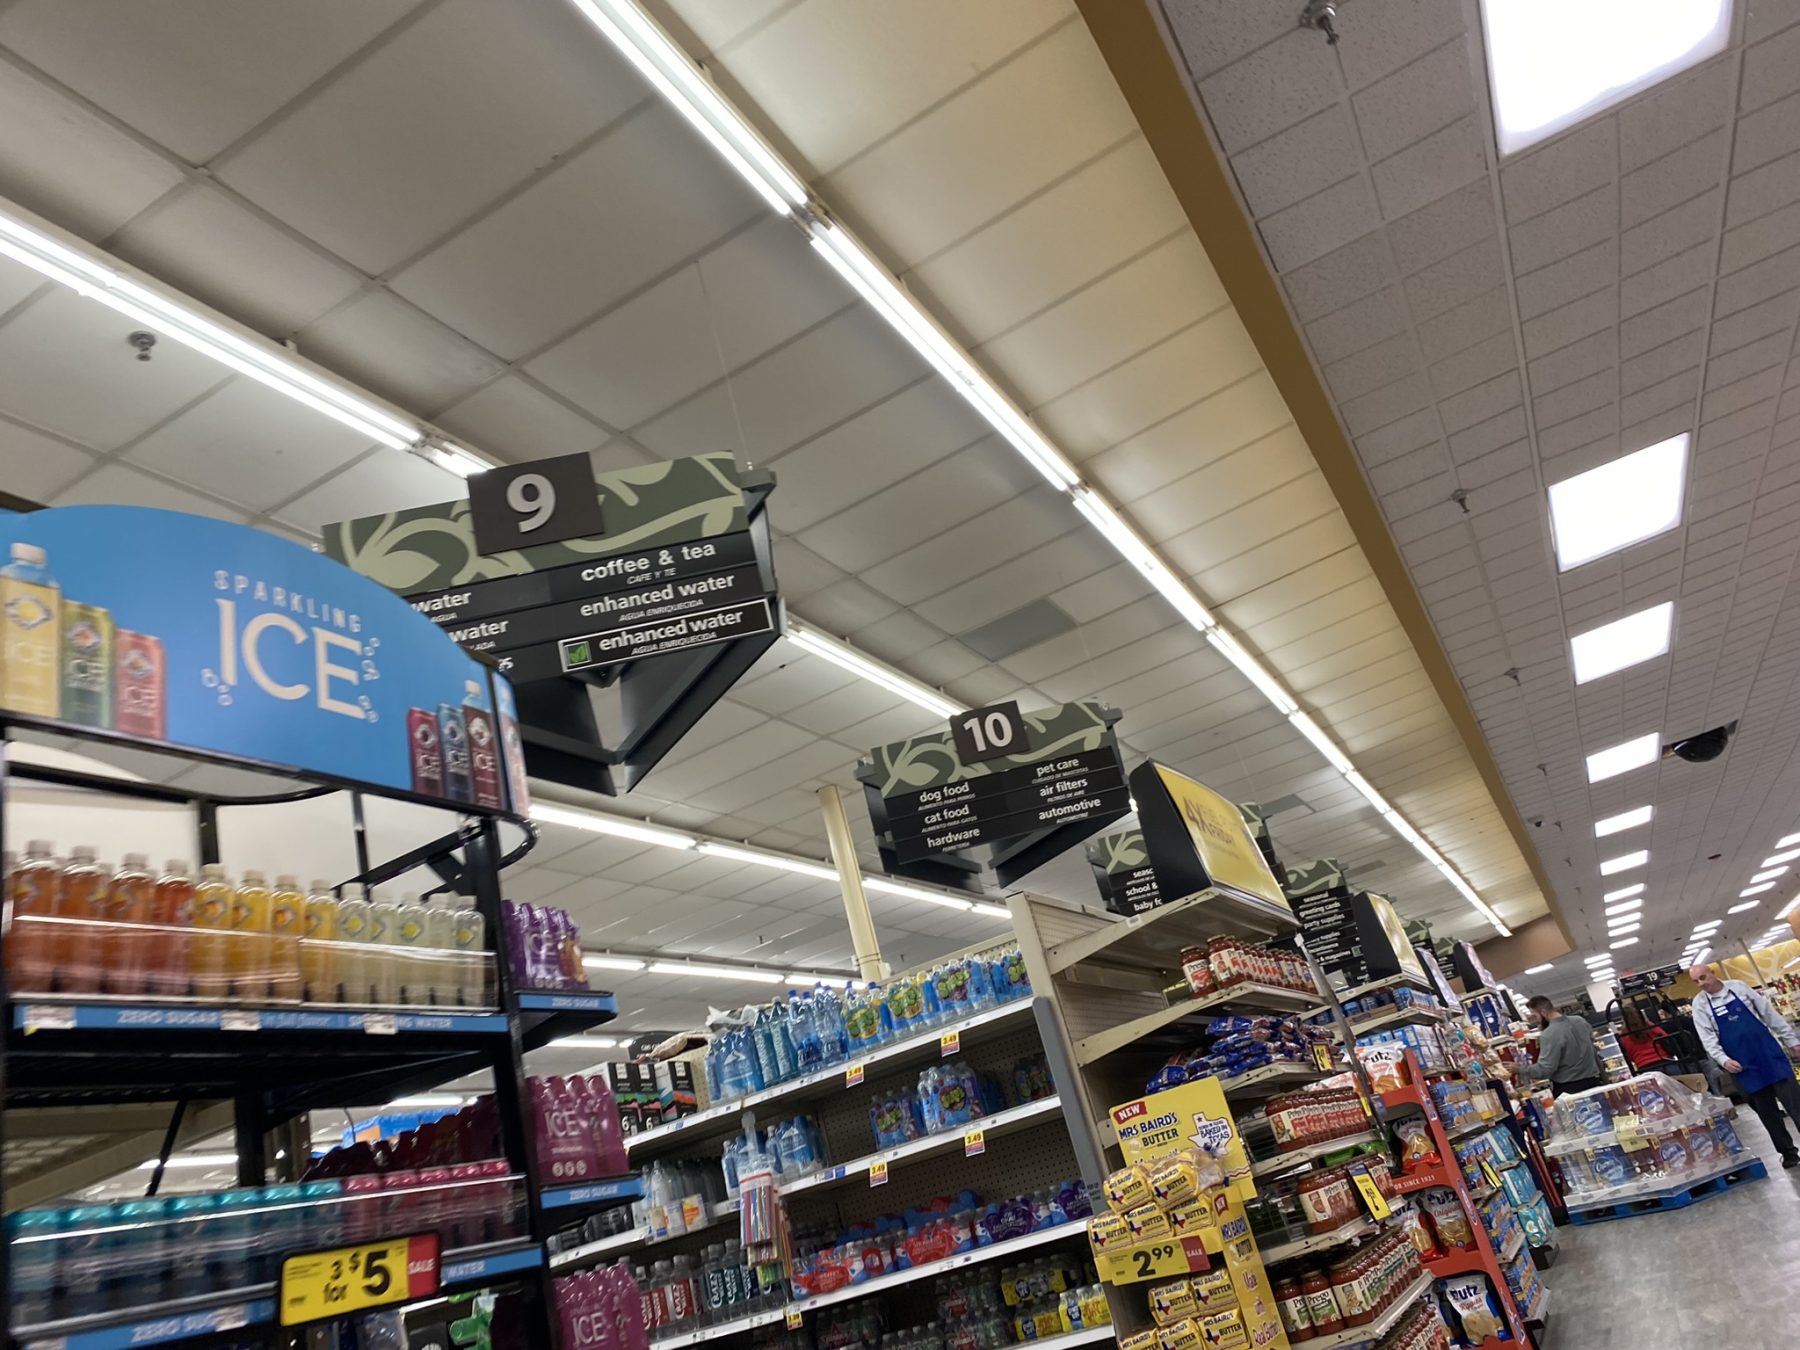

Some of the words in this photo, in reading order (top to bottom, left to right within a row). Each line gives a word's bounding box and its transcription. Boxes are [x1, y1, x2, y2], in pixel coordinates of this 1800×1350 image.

[506, 474, 556, 533] 9
[581, 557, 650, 582] coffee
[658, 549, 675, 567] &
[681, 543, 716, 561] tea
[213, 568, 363, 633] SPARKLING
[411, 592, 472, 613] water
[580, 584, 675, 617] enhanced
[677, 574, 735, 597] water
[448, 620, 509, 642] water
[598, 620, 689, 651] enhanced
[689, 610, 743, 632] water
[215, 597, 366, 719] ICE
[963, 712, 1013, 752] 10
[1036, 763, 1055, 777] pet
[1056, 758, 1079, 770] care
[920, 791, 941, 802] dog
[943, 781, 969, 797] food
[1040, 785, 1053, 797] air
[1056, 778, 1088, 792] filters
[925, 812, 942, 824] cat
[943, 804, 969, 819] food
[1039, 798, 1101, 820] automotive
[927, 828, 980, 848] hardware
[1126, 883, 1151, 896] school
[1151, 882, 1158, 890] &
[1134, 901, 1153, 911] baby
[1647, 972, 1658, 982] 19
[1118, 1104, 1141, 1121] NEW
[544, 1109, 582, 1138] ICE
[1119, 1125, 1138, 1140] MRS
[1139, 1111, 1178, 1133] BAIRD'S
[1200, 1125, 1221, 1138] BAKED
[1142, 1128, 1179, 1148] BUTTER
[1403, 1179, 1420, 1188] SINCE
[1422, 1174, 1435, 1184] 1921
[1187, 1248, 1202, 1257] SALE
[331, 1260, 343, 1280] 3
[408, 1260, 434, 1275] SALE
[447, 1260, 485, 1279] WATER
[323, 1283, 348, 1304] for
[1208, 1284, 1232, 1296] BUTTER
[1306, 1290, 1330, 1305] Prego
[1169, 1294, 1192, 1307] BUTTER
[572, 1311, 608, 1348] ICE
[1219, 1322, 1242, 1336] BUTTER
